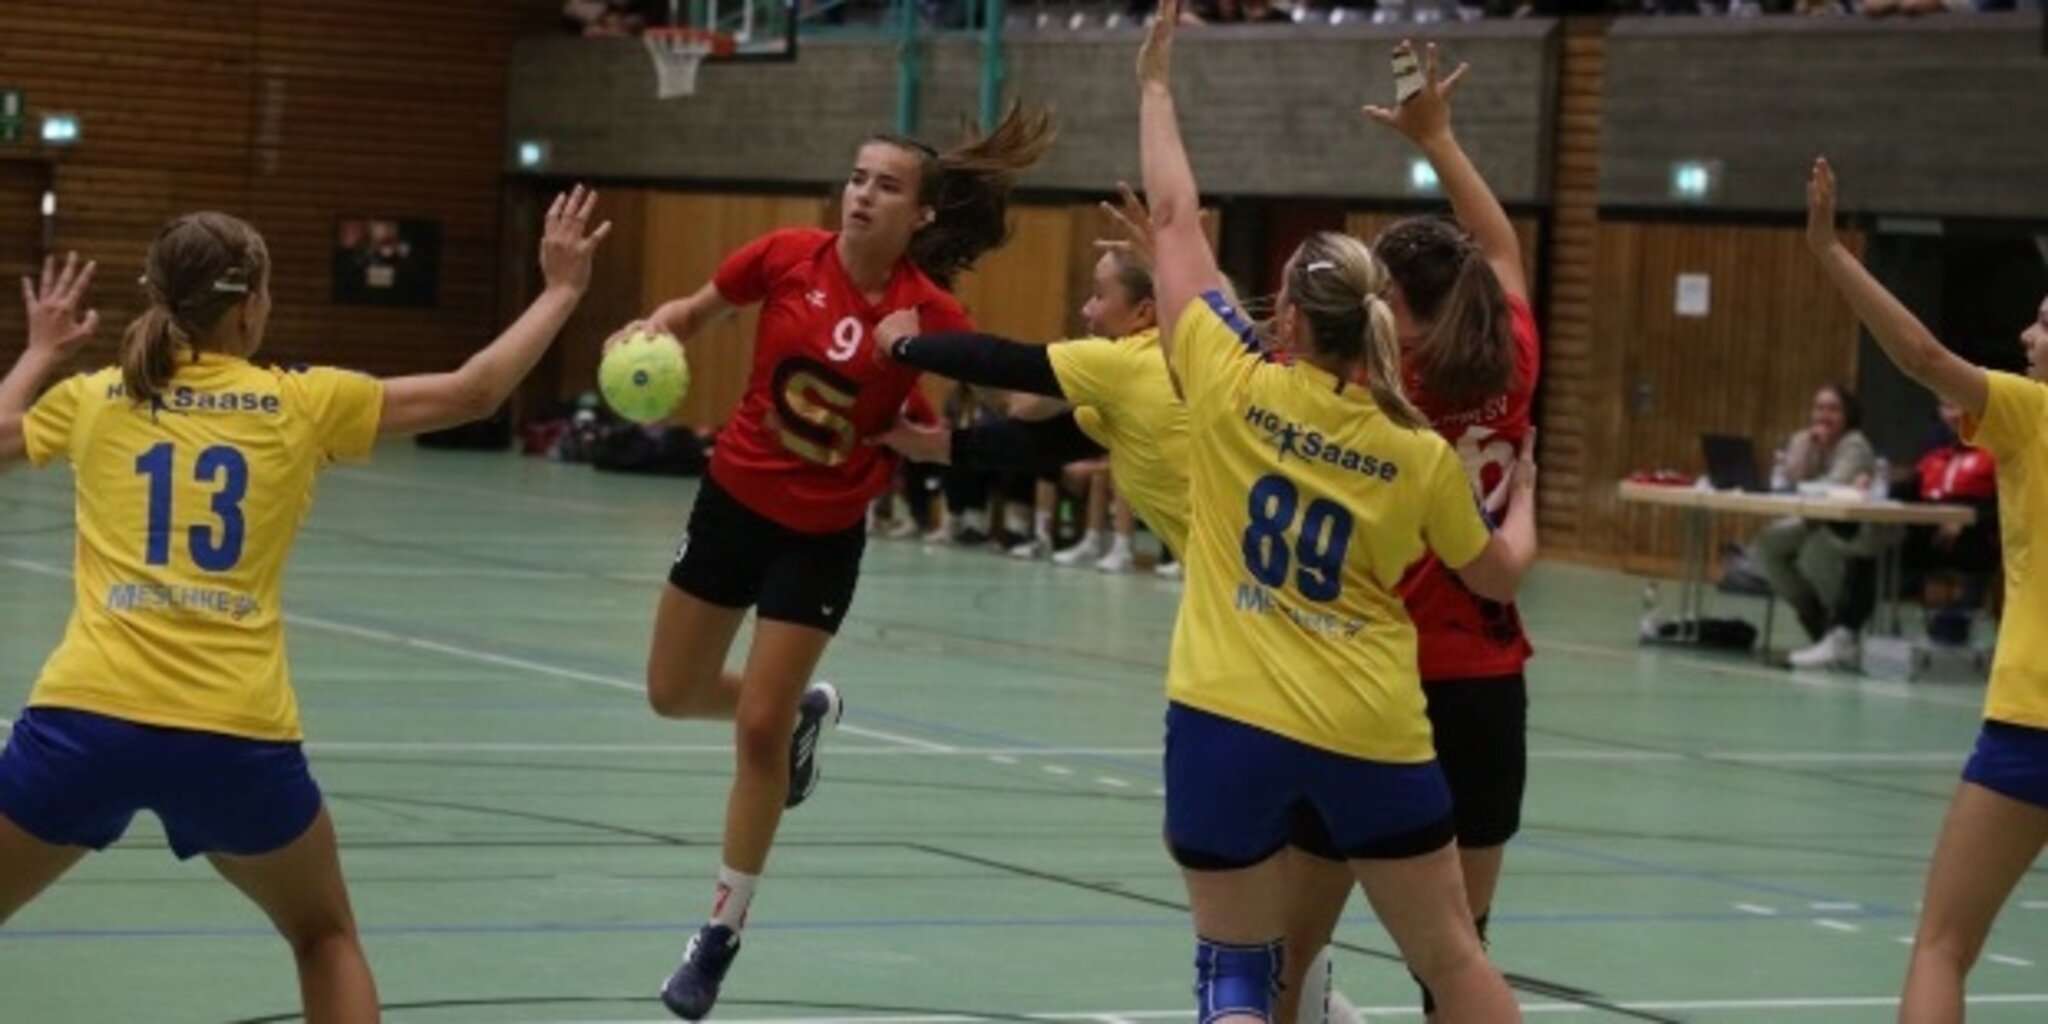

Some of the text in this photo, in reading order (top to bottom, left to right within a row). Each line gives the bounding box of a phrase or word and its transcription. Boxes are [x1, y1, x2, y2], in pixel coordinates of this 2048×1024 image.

[827, 316, 863, 361] 9
[174, 386, 280, 413] Saase
[1245, 405, 1399, 481] HG Saase
[135, 441, 249, 573] 13
[1242, 473, 1354, 603] 89
